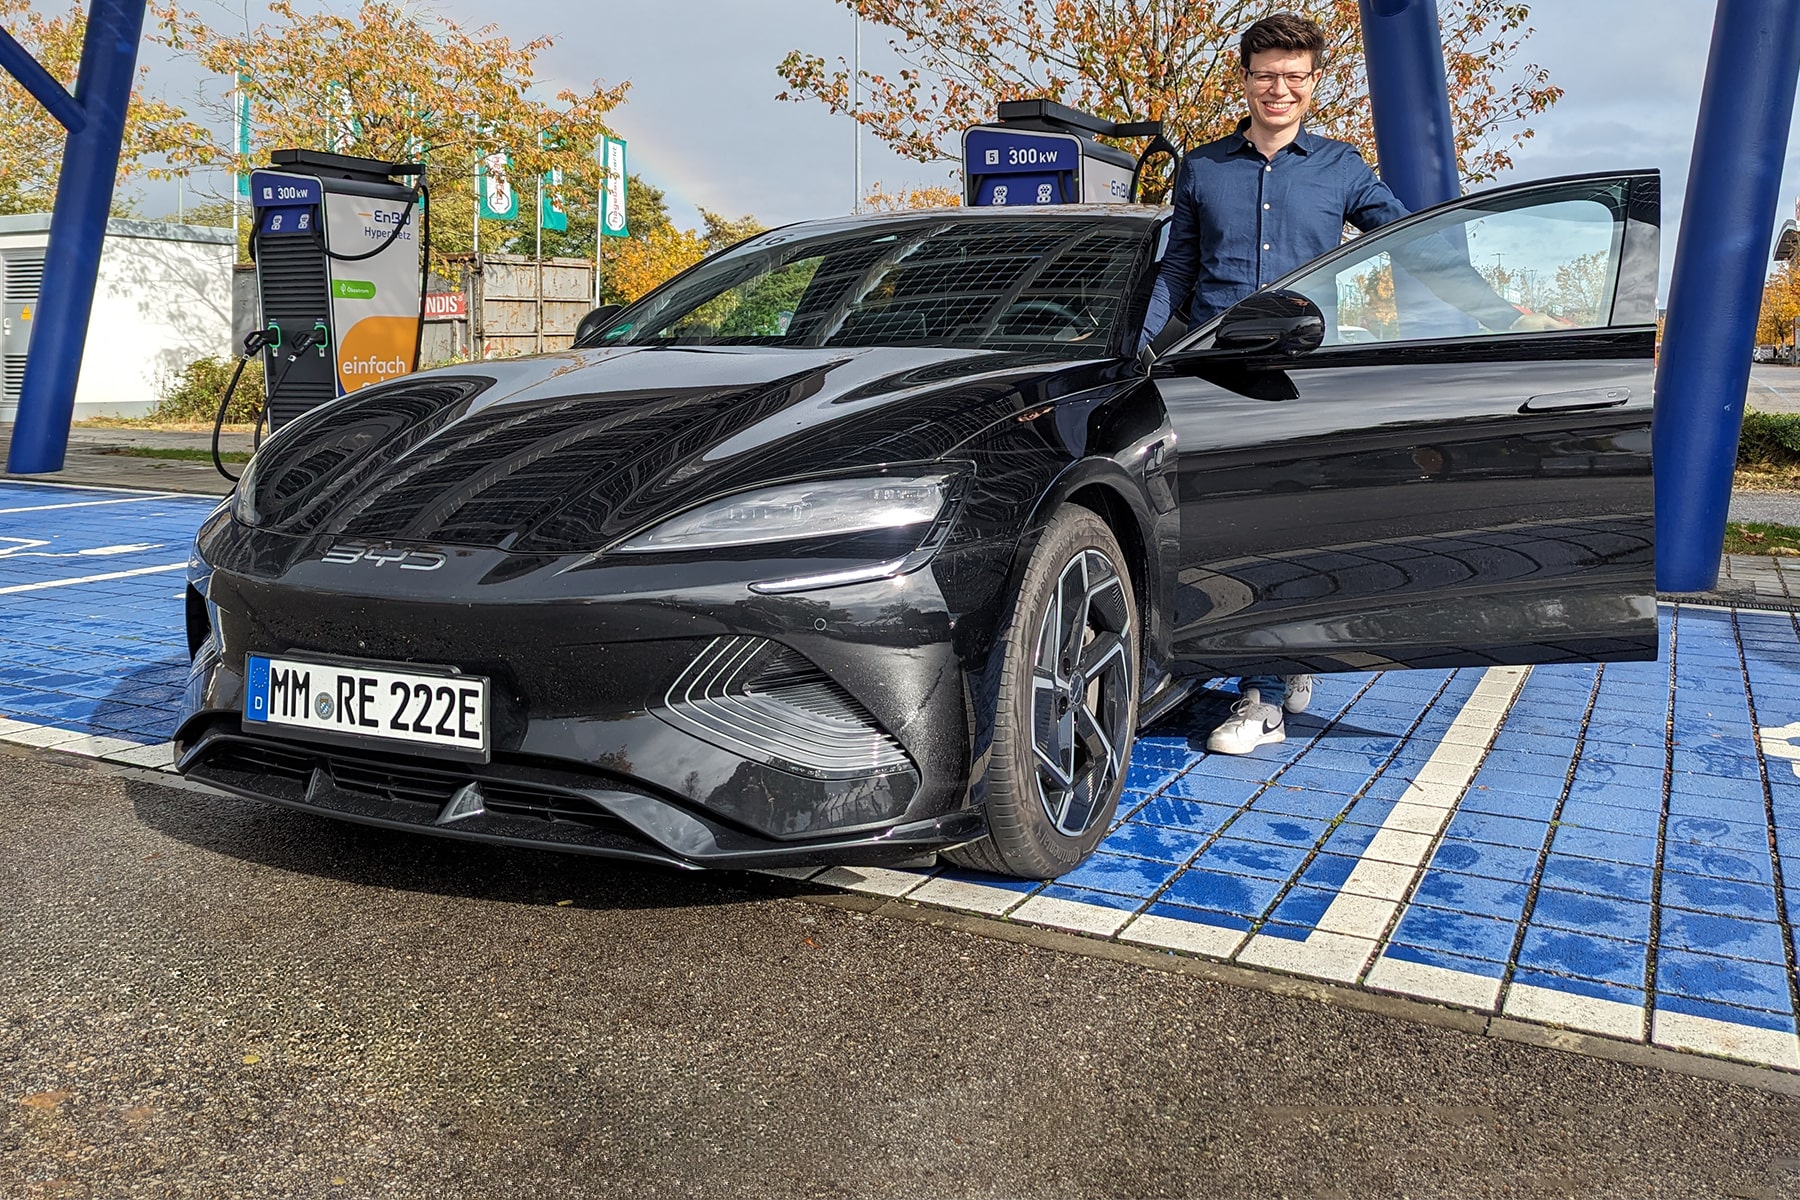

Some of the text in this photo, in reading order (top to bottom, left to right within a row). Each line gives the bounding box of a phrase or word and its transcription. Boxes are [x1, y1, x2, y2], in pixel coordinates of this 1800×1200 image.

[1008, 149, 1037, 164] 300
[1040, 151, 1058, 163] kW
[277, 187, 296, 199] 300
[296, 189, 308, 198] kW
[364, 226, 412, 240] Hyperetz
[419, 295, 458, 313] NDIS
[342, 356, 406, 375] einfach
[254, 667, 480, 740] D MM RE 222E
